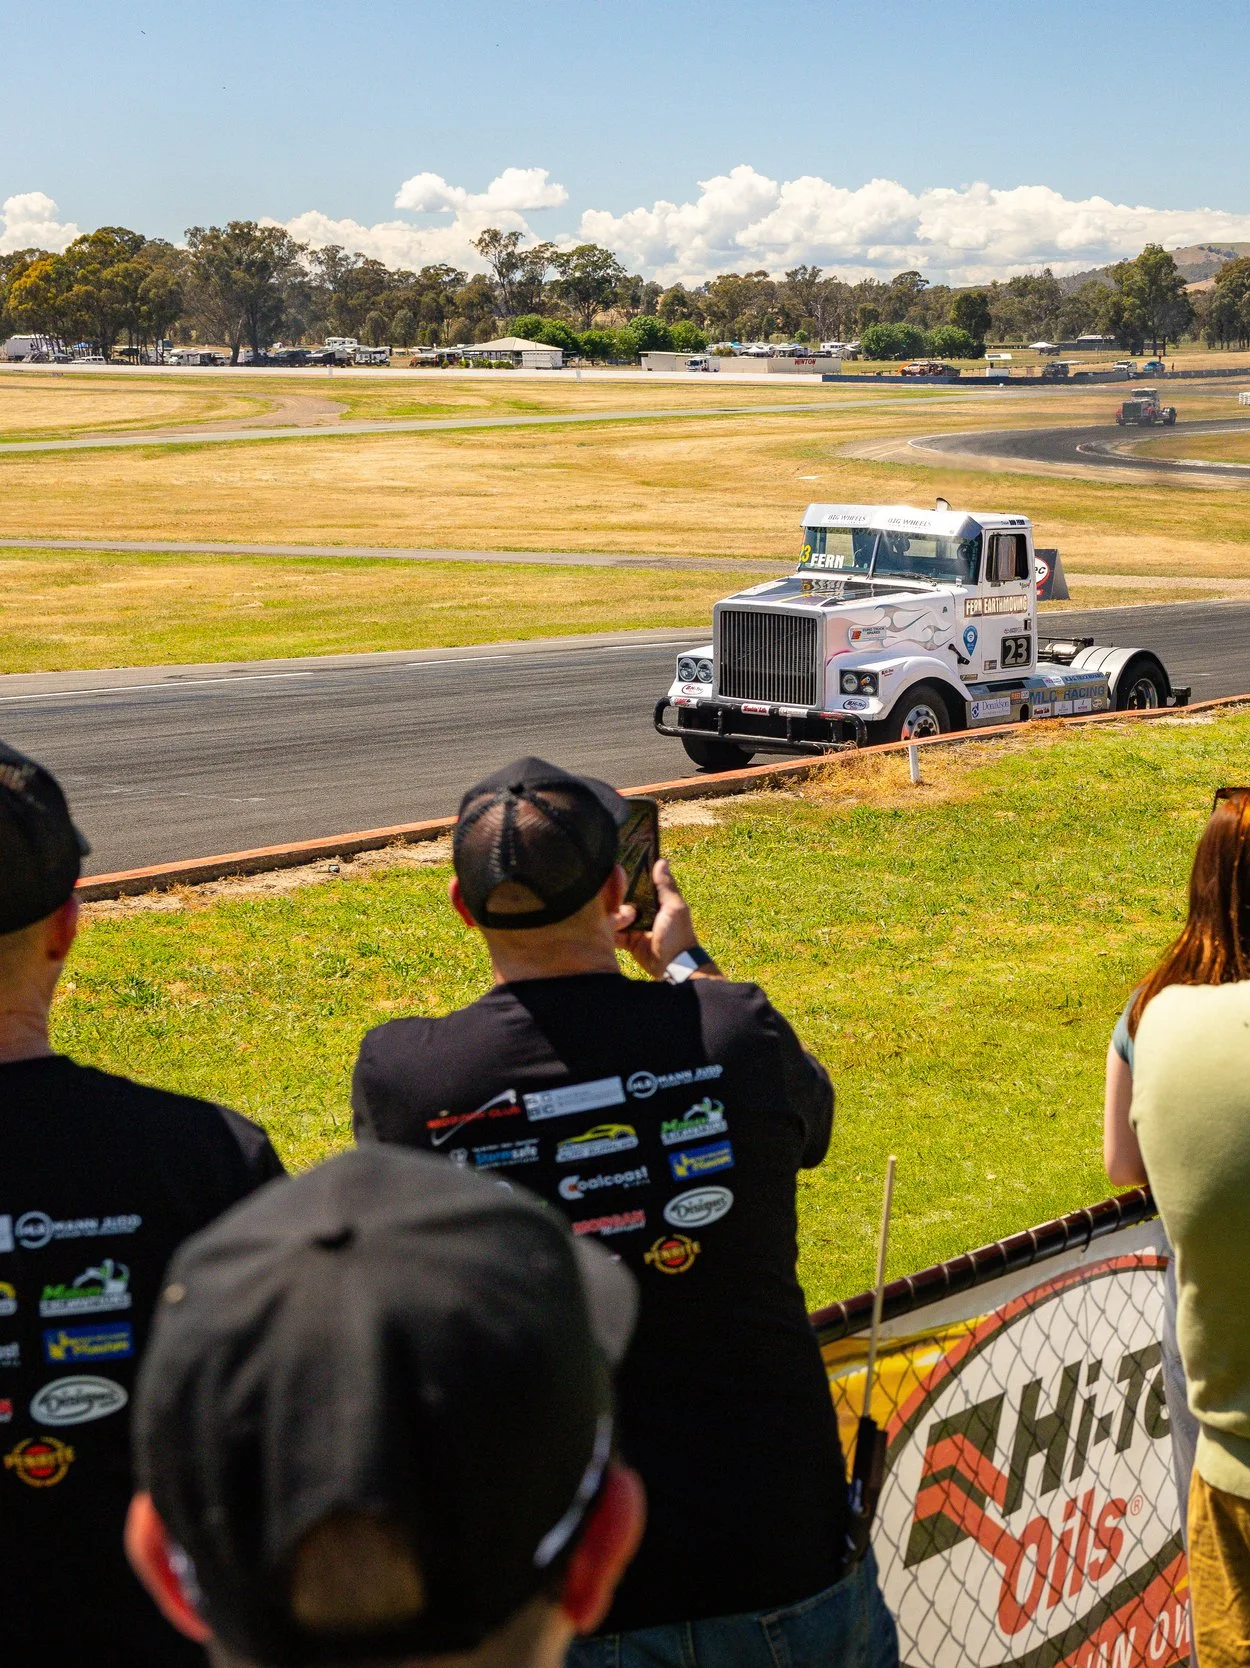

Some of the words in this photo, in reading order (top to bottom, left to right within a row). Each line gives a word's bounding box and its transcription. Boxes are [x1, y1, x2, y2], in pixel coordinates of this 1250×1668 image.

[827, 513, 841, 521] BIG
[841, 514, 867, 522] WHEELS
[887, 517, 902, 525] BIG
[903, 518, 932, 527] WHEELS
[810, 553, 845, 569] FERN
[966, 598, 982, 616] FERN
[984, 595, 1028, 614] EARTHMOVING
[1005, 638, 1028, 665] 23
[981, 697, 1010, 711] Donaldson
[1029, 690, 1058, 705] MLC
[1063, 686, 1105, 701] RACING
[558, 1165, 649, 1201] Coalcoast
[1001, 1340, 1173, 1520] Hi-Te
[998, 1486, 1131, 1637] Oils
